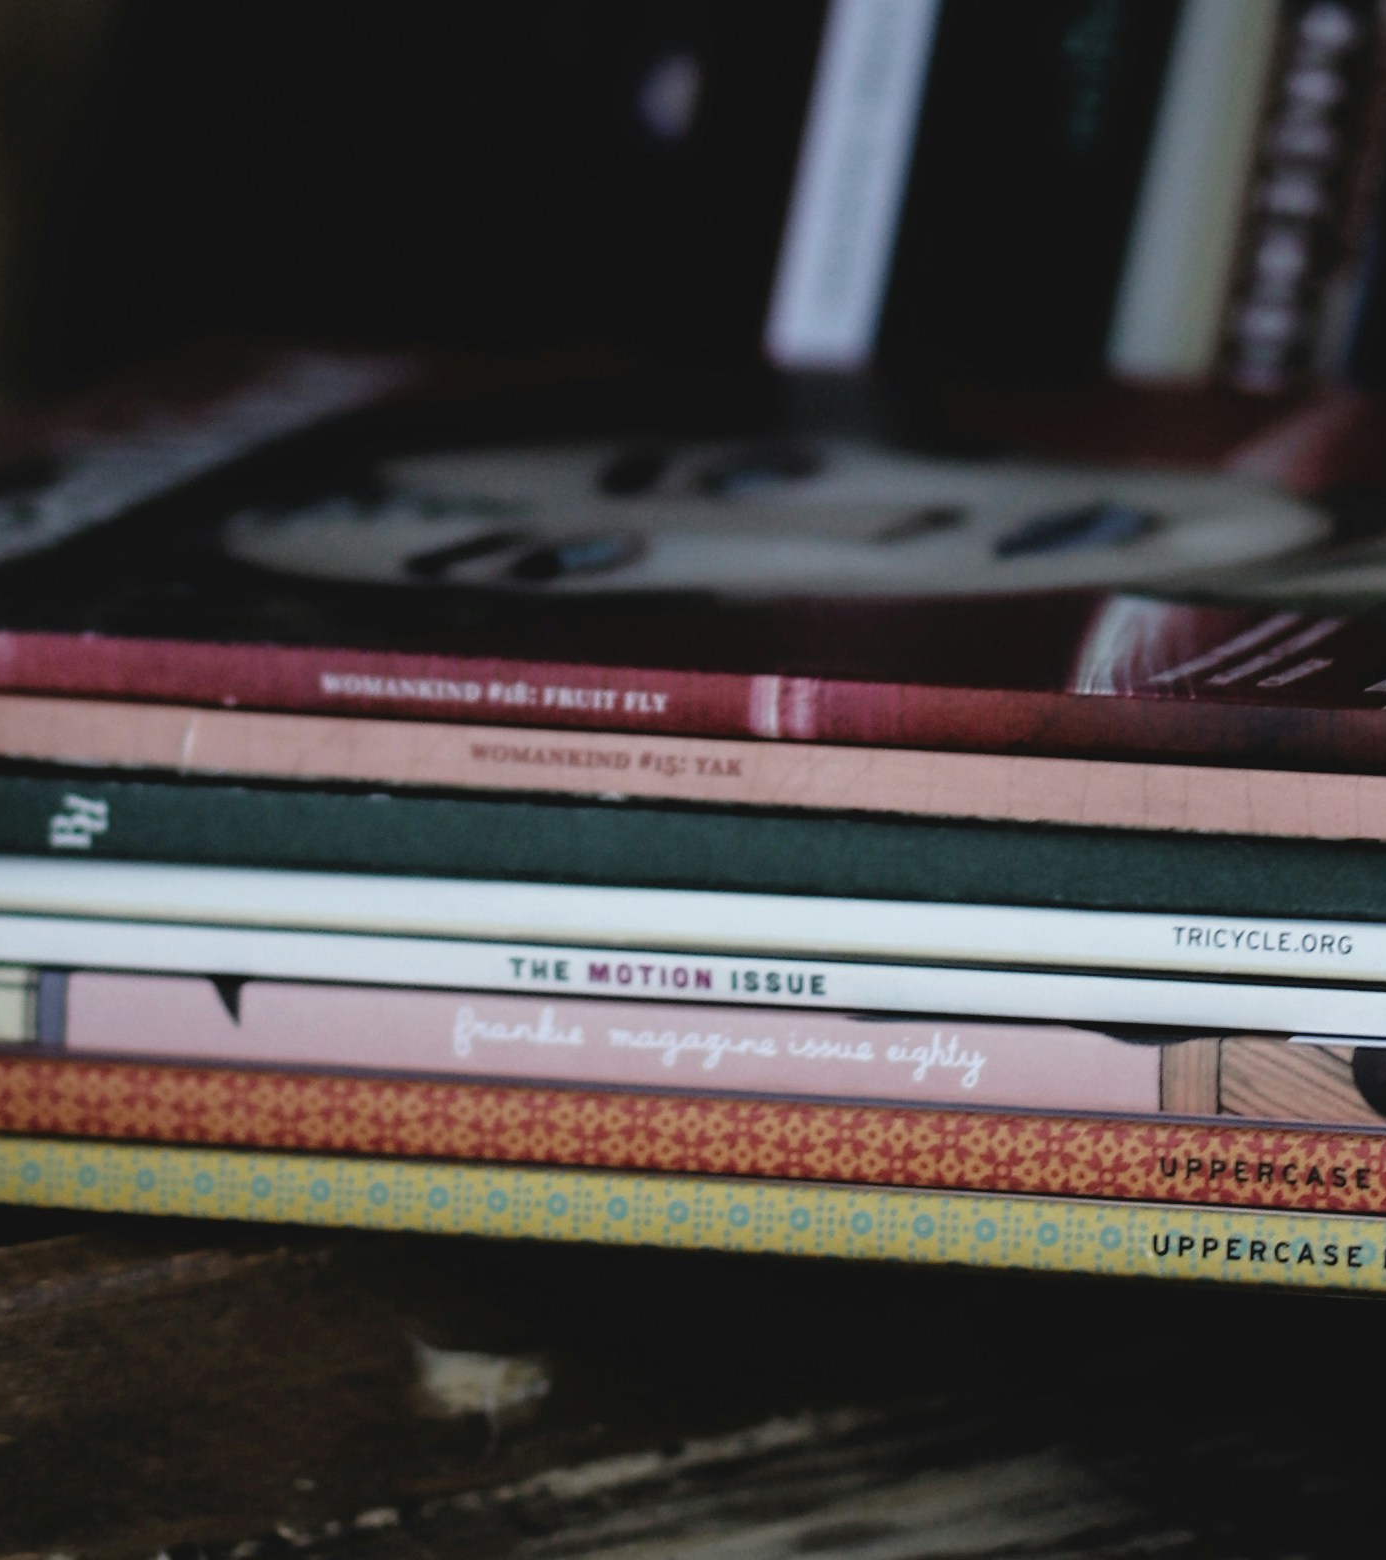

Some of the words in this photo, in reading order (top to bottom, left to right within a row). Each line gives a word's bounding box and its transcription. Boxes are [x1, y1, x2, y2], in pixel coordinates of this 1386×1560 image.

[320, 672, 480, 704] WOMANKIND
[542, 684, 618, 712] FRUIT
[623, 690, 670, 715] FLY
[470, 743, 631, 772] WOMANKIND
[694, 756, 743, 778] YAK
[1171, 926, 1354, 957] TRICYCLE.ORG
[509, 957, 571, 981] THE
[587, 962, 714, 991] MOTION
[731, 970, 826, 995] ISSUE
[452, 1004, 585, 1058] frankie
[606, 1024, 778, 1070] magazine
[787, 1030, 876, 1062] issue
[885, 1028, 988, 1088] eighty
[1158, 1155, 1371, 1190] UPPERCASE
[1152, 1233, 1363, 1268] UPPERCASE
